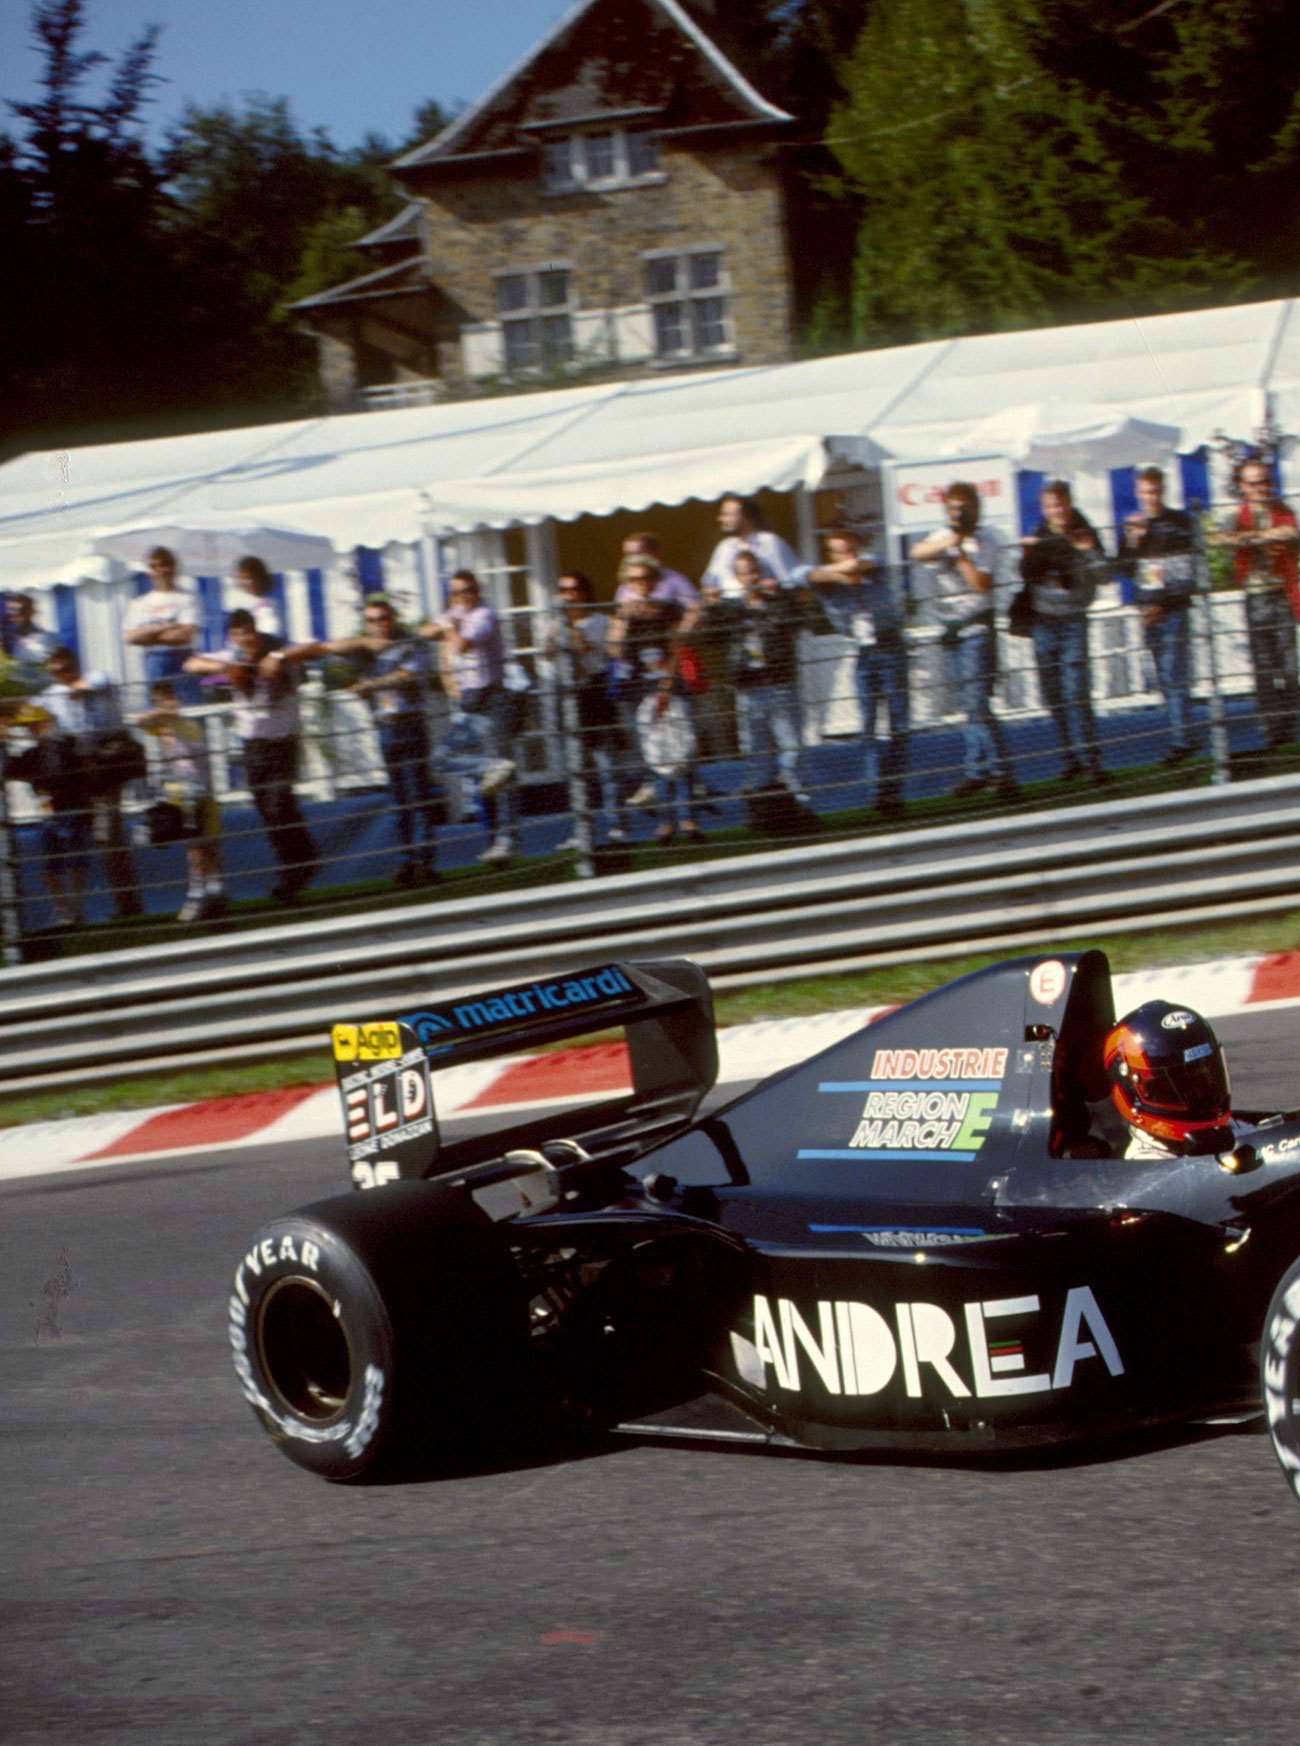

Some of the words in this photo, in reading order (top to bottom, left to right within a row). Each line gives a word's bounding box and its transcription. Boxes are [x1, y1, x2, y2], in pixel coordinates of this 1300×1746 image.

[452, 967, 632, 1029] matricardi
[357, 1027, 397, 1056] Agip
[870, 1048, 1009, 1080] INDUSTRIE
[863, 1092, 970, 1120] REGION
[849, 1120, 962, 1148] MARCH
[730, 1285, 1125, 1398] ANDREA
